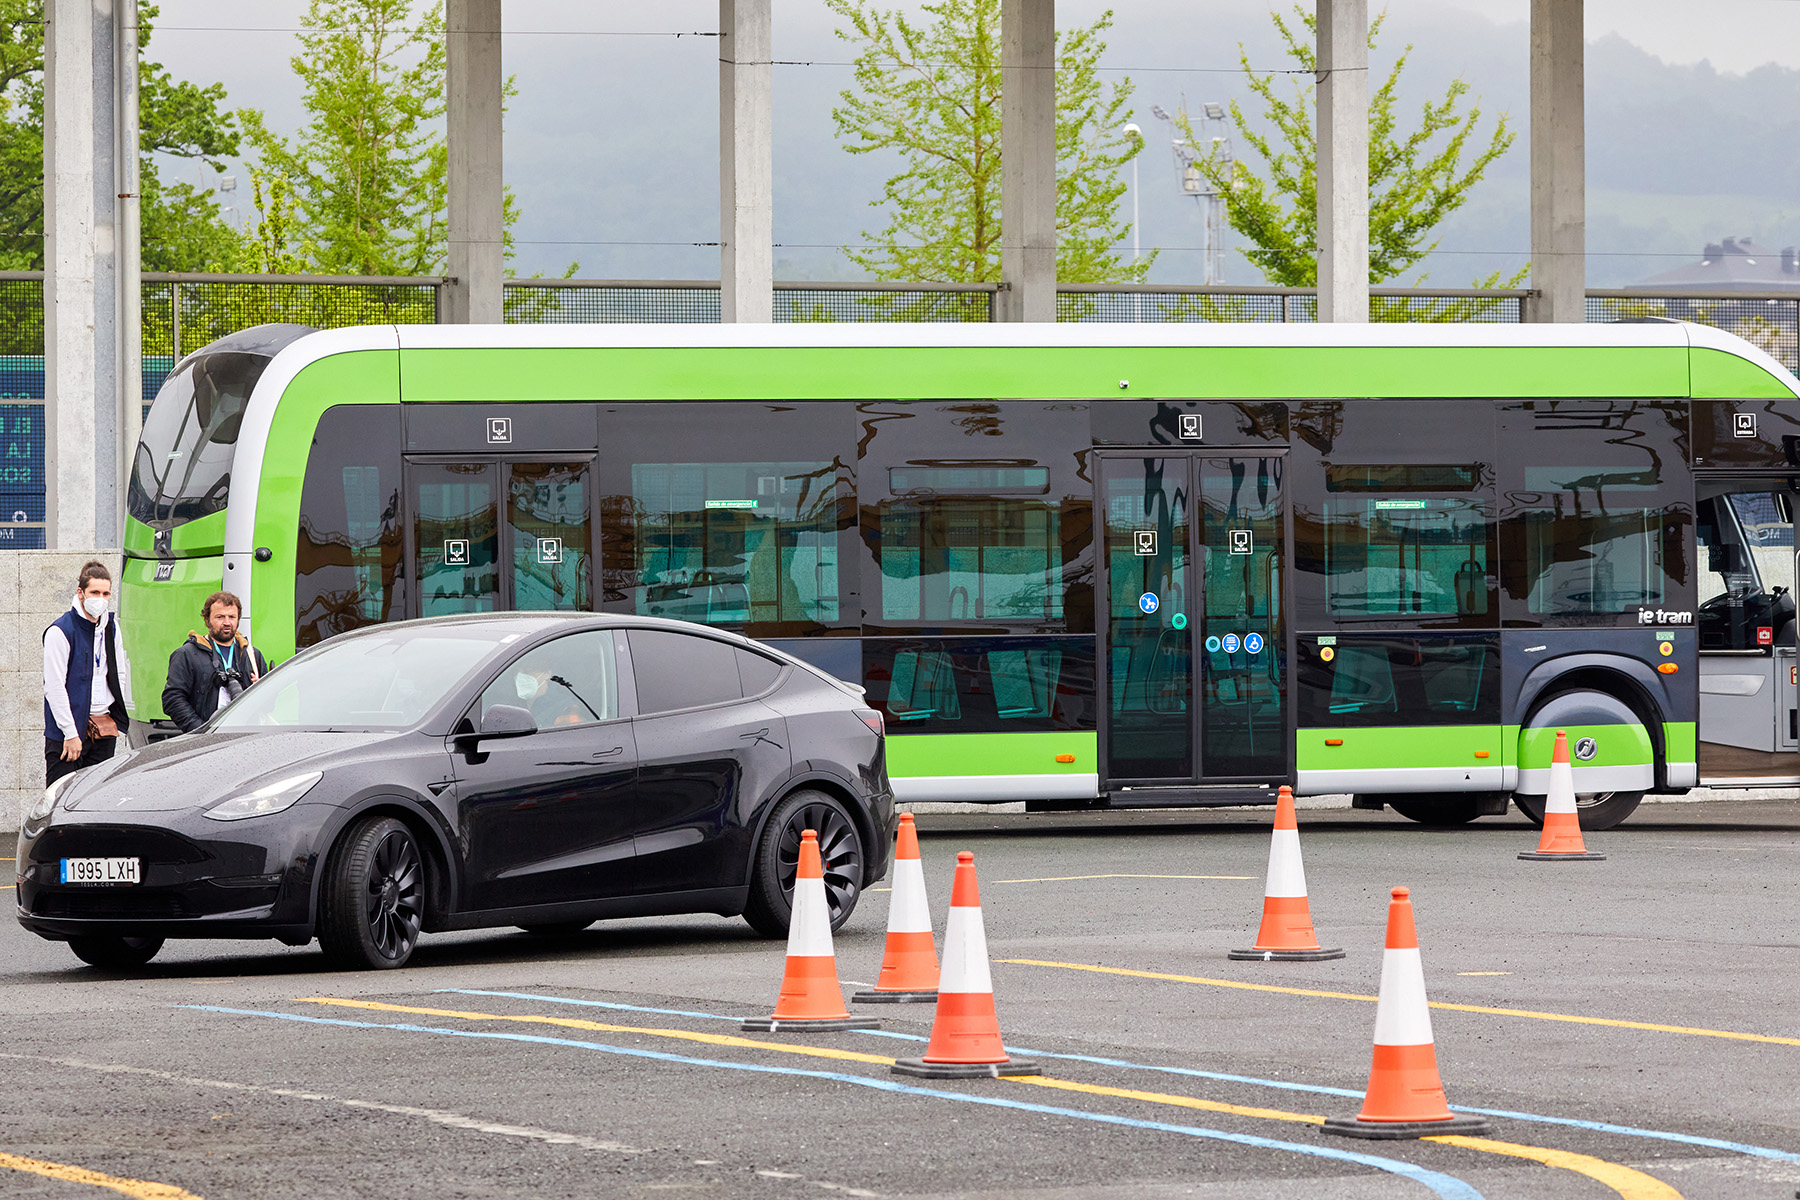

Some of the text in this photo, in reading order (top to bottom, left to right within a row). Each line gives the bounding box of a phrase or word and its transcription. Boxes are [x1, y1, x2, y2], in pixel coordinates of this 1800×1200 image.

[1638, 607, 1692, 624] ie tram
[71, 862, 135, 880] 1995 LXH
